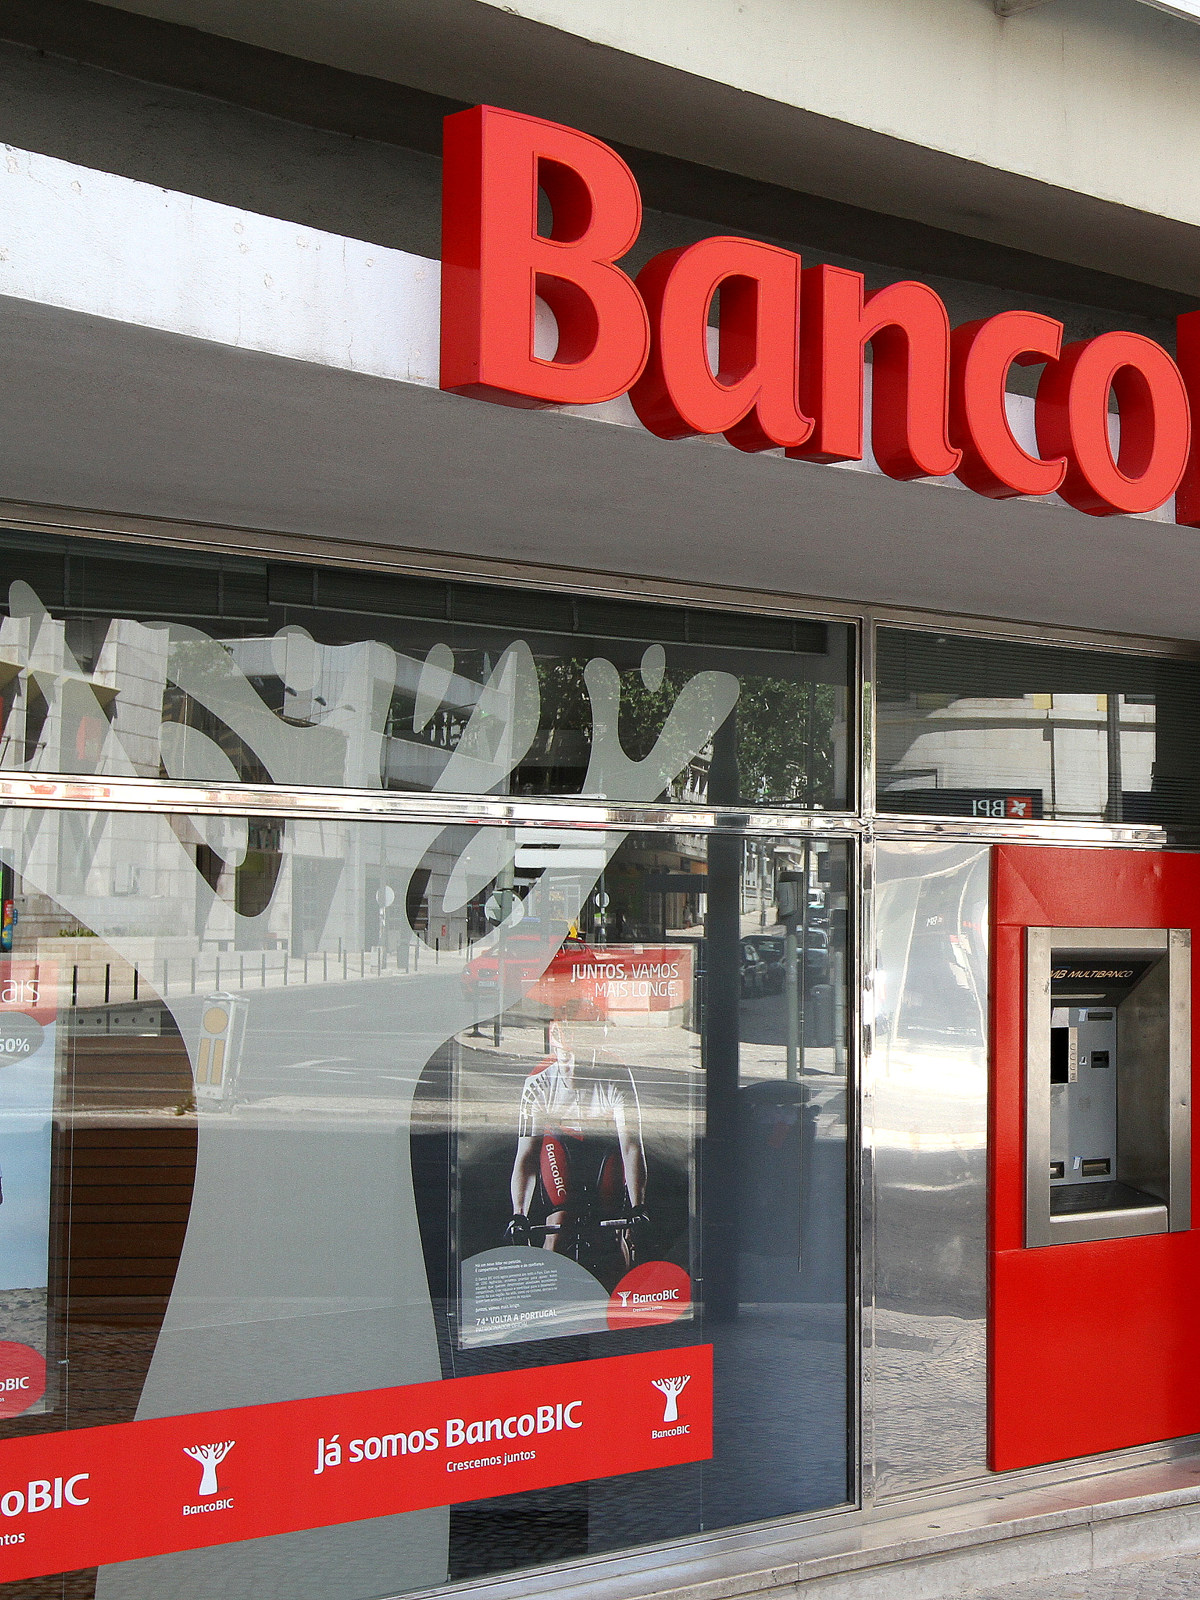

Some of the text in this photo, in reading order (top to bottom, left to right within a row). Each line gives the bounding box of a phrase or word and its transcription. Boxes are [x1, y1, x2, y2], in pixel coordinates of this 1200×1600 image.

[570, 963, 679, 983] JUNTOS, VAMOS
[1068, 970, 1133, 978] MULTIBANCO
[595, 980, 678, 998] MAIS LONGE.
[545, 1143, 567, 1197] BancoBIC
[632, 1288, 680, 1304] BancoBIC
[490, 1314, 512, 1324] VOLTA
[513, 1313, 519, 1321] A
[520, 1309, 558, 1321] PORTUGAL
[313, 1400, 584, 1475] Já somos BancoBIC
[651, 1424, 691, 1439] BancoBIC
[446, 1450, 536, 1473] Crescemos juntos
[182, 1498, 235, 1516] BancoBIC
